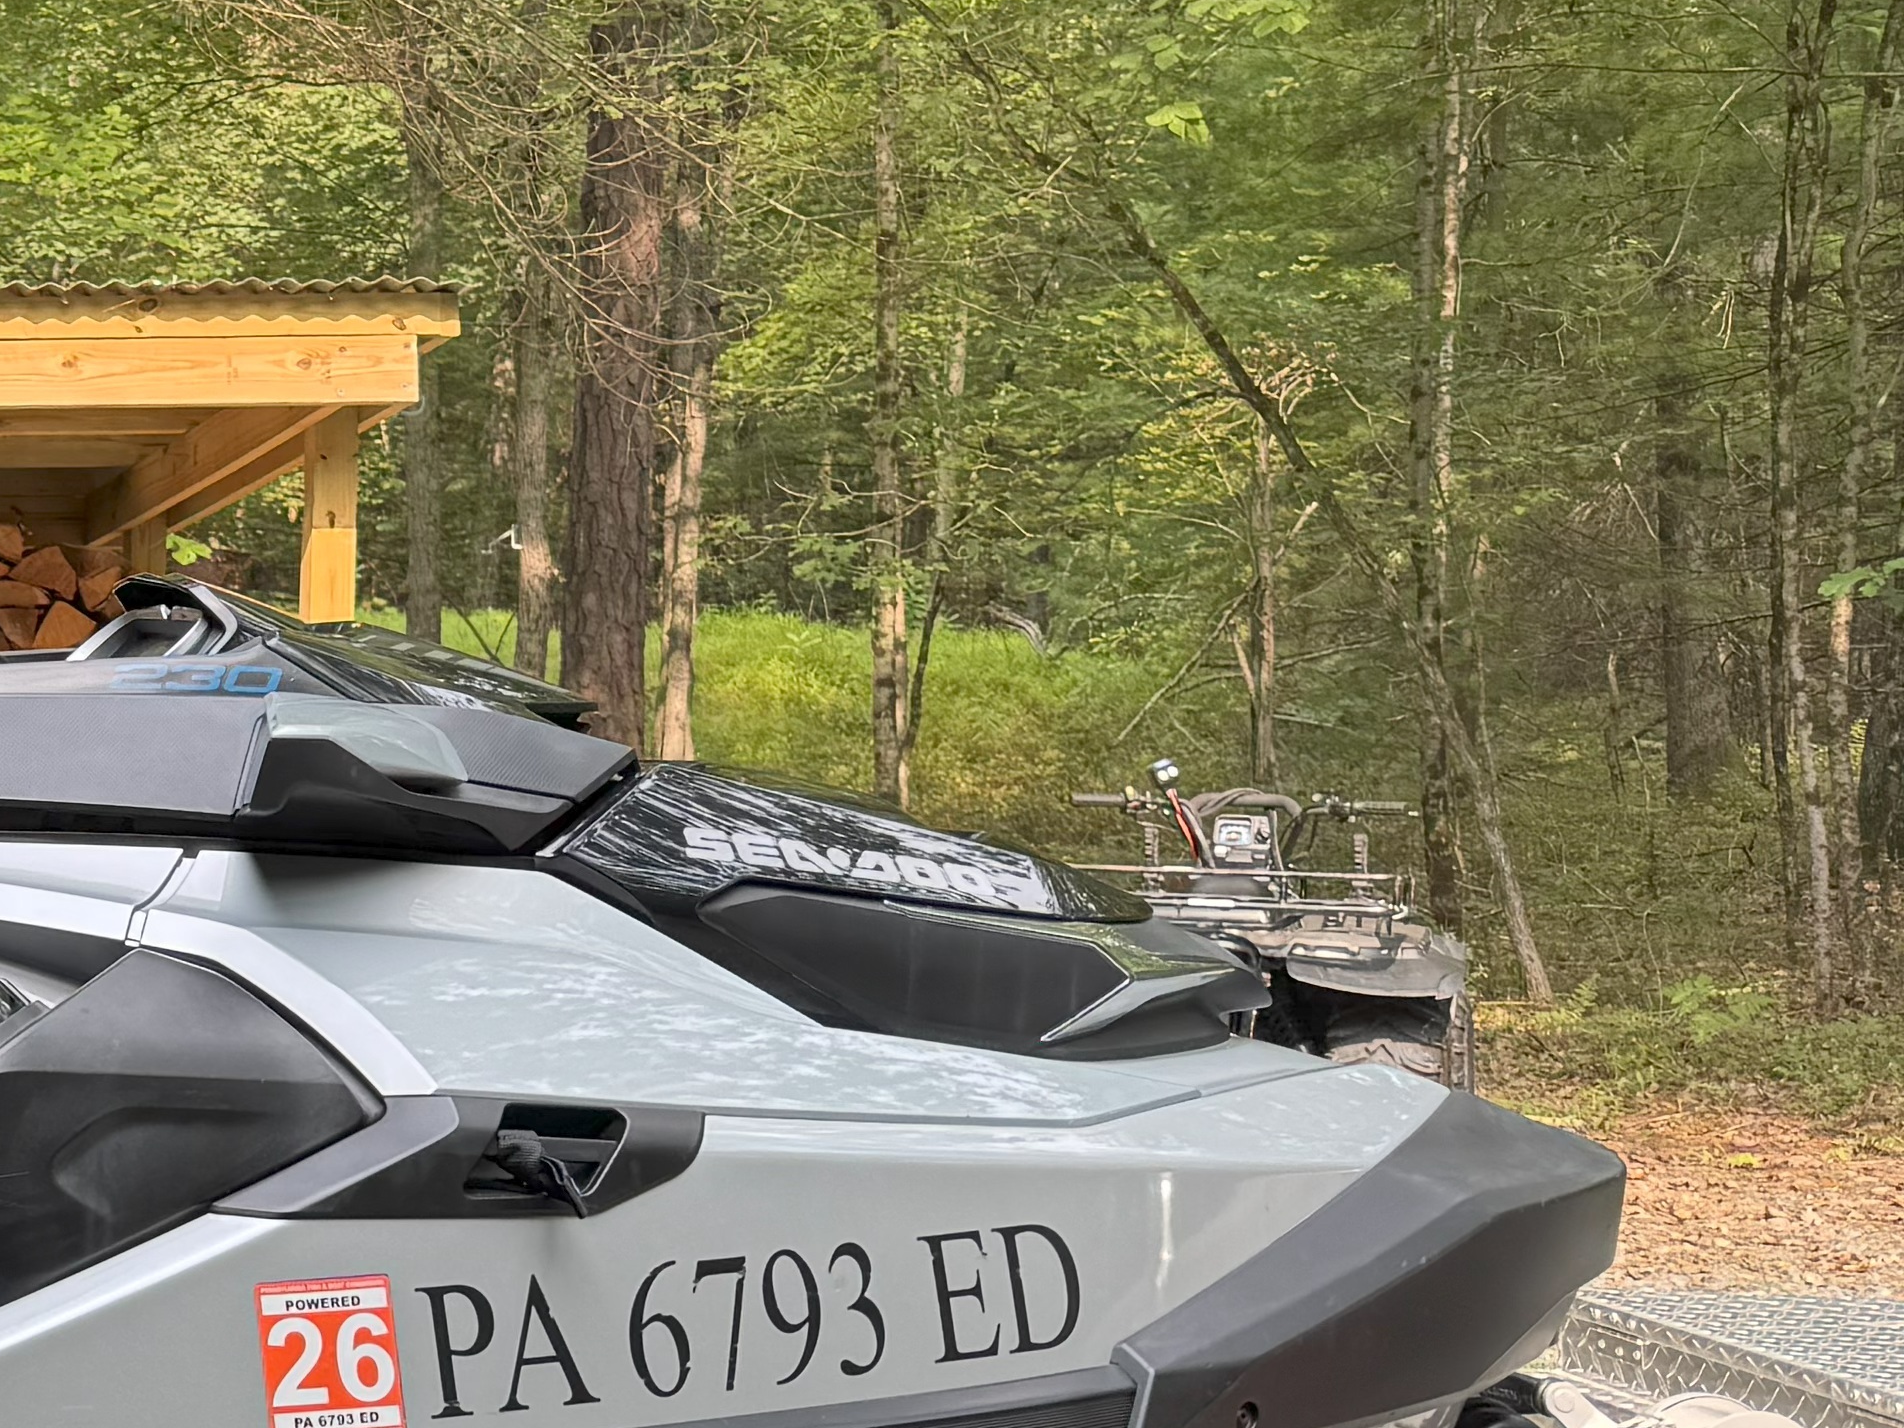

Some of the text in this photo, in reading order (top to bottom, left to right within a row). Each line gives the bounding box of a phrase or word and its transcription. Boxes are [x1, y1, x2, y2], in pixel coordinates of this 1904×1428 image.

[109, 662, 283, 694] 230
[285, 1295, 361, 1312] POWERED
[415, 1223, 1082, 1420] PA 6793 ED
[267, 1312, 395, 1408] 26
[294, 1416, 314, 1428] PA
[360, 1411, 380, 1424] ED
